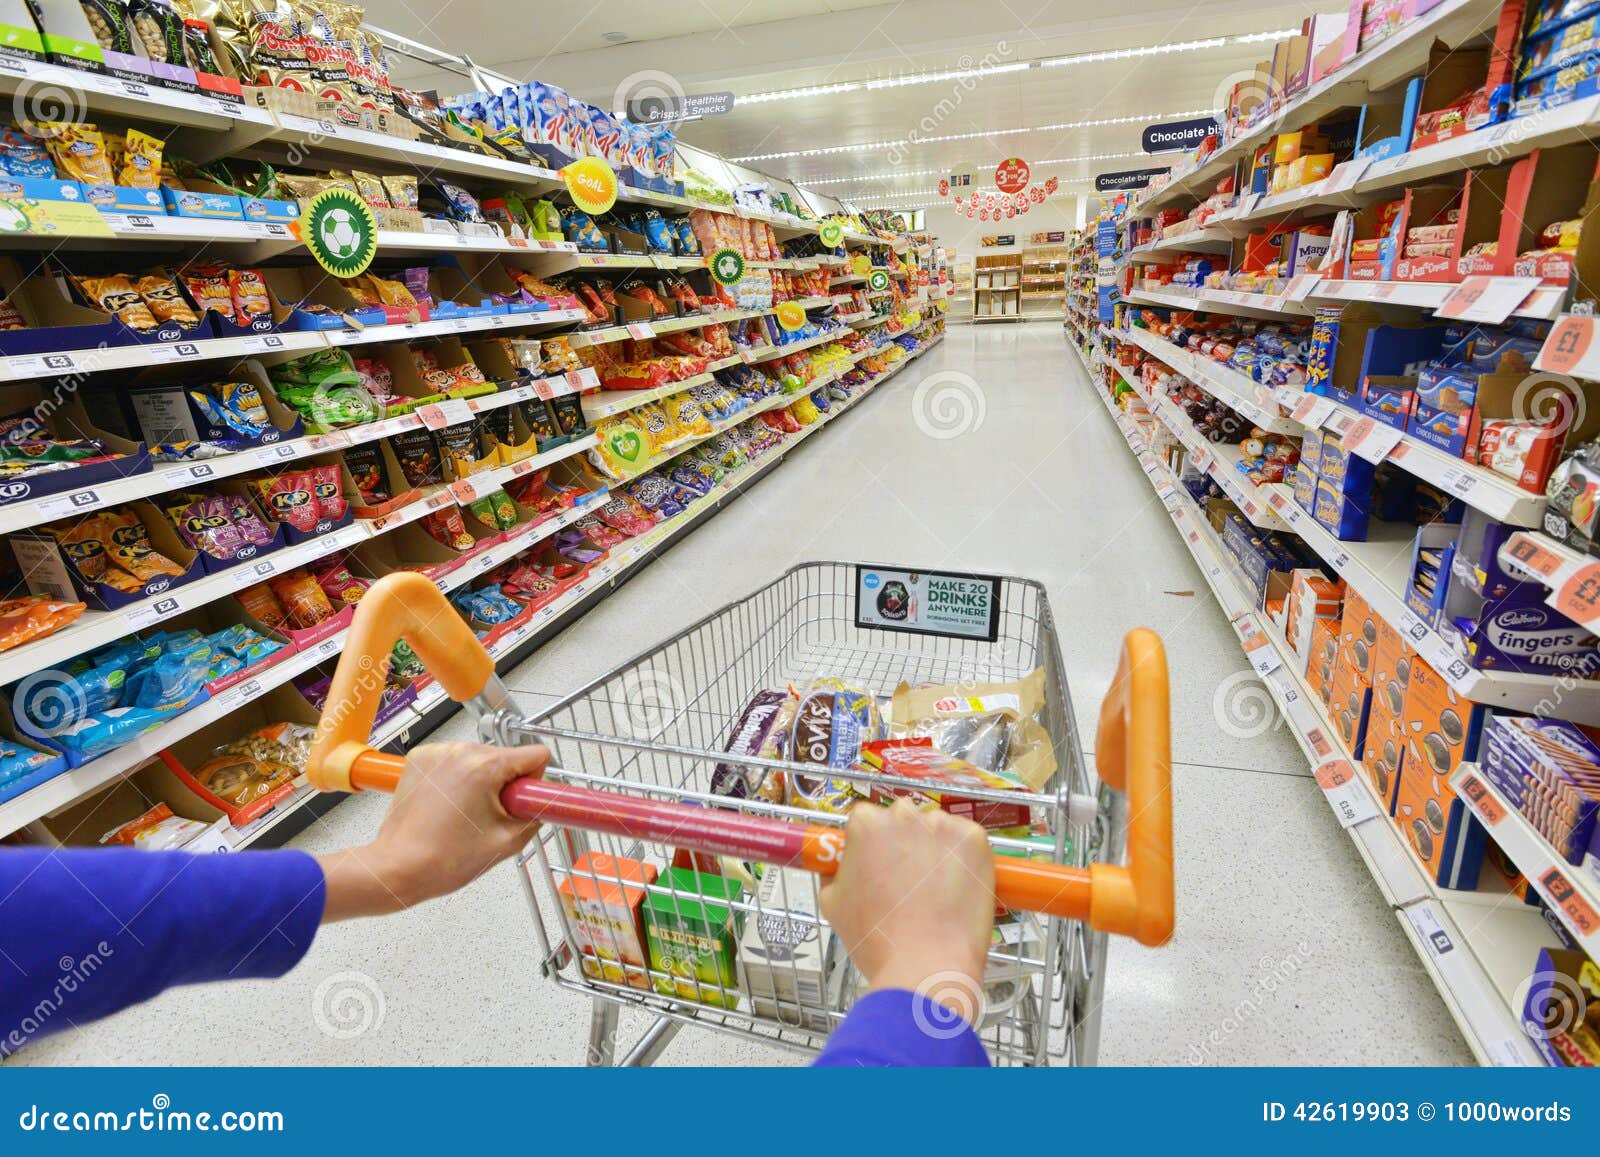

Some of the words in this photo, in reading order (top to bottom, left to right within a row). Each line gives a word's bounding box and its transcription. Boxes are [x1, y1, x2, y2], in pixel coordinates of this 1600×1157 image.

[0, 46, 37, 60] onderful
[59, 55, 99, 70] Wonderful
[113, 69, 150, 82] Wonderful
[163, 80, 196, 92] Wonderful
[208, 91, 240, 103] Wonderful
[684, 94, 728, 107] Healthier
[649, 109, 680, 120] Crisps
[691, 104, 727, 116] Snacks
[1150, 125, 1205, 144] Chocolate
[577, 174, 606, 193] GOAL
[997, 170, 1007, 185] 3
[1017, 168, 1028, 184] 2
[1100, 174, 1136, 186] Chocolate
[161, 330, 179, 340] KP
[1557, 330, 1581, 353] £1
[264, 433, 279, 443] KP
[1416, 426, 1431, 440] CHOCO
[464, 485, 474, 494] £2
[275, 492, 310, 507] KP
[189, 515, 225, 530] KP
[240, 547, 255, 556] KP
[150, 582, 166, 592] KP
[928, 580, 966, 592] MAKE
[970, 583, 988, 594] 20
[159, 599, 174, 611] £2
[928, 590, 988, 607] DRINKS
[928, 604, 987, 617] ANYWHERE
[1499, 611, 1546, 627] Cadbury
[1499, 631, 1574, 652] fingers
[1530, 652, 1585, 669] miis
[1413, 667, 1426, 684] 36
[1325, 762, 1335, 770] 2
[1332, 773, 1345, 786] £3
[758, 919, 812, 933] ORGNIC
